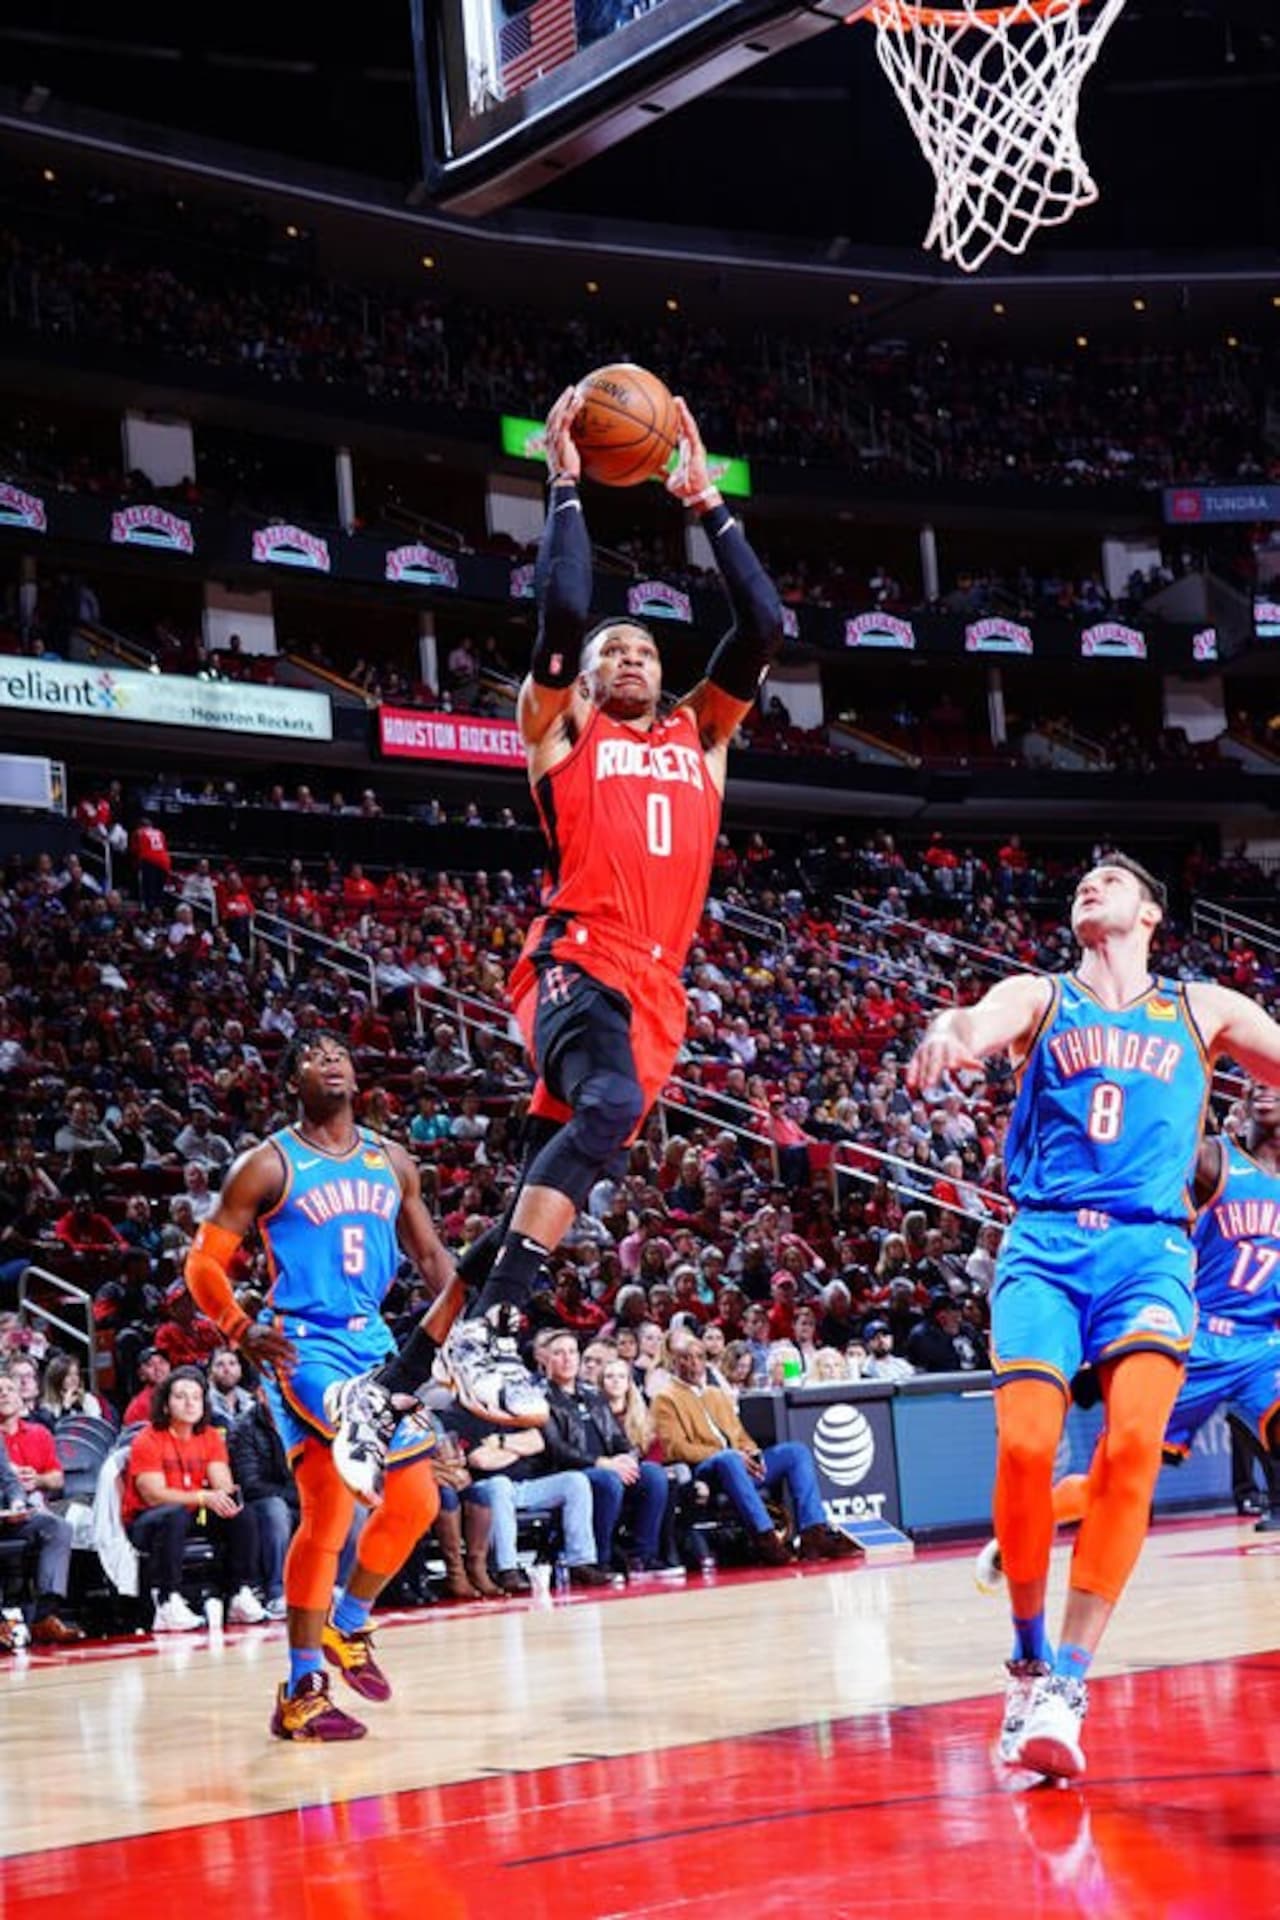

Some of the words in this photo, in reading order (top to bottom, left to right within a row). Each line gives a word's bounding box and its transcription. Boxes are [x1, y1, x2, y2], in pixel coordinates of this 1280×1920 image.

[192, 704, 254, 726] Houston
[257, 712, 315, 733] Rockets
[384, 716, 457, 749] HOUSTON
[596, 739, 704, 791] ROCKETS
[646, 793, 672, 858] 0
[1050, 1025, 1183, 1084] THUNDER
[1087, 1081, 1124, 1145] 8
[296, 1178, 398, 1226] THUNDER
[341, 1225, 366, 1276] 5
[1228, 1240, 1280, 1295] 17
